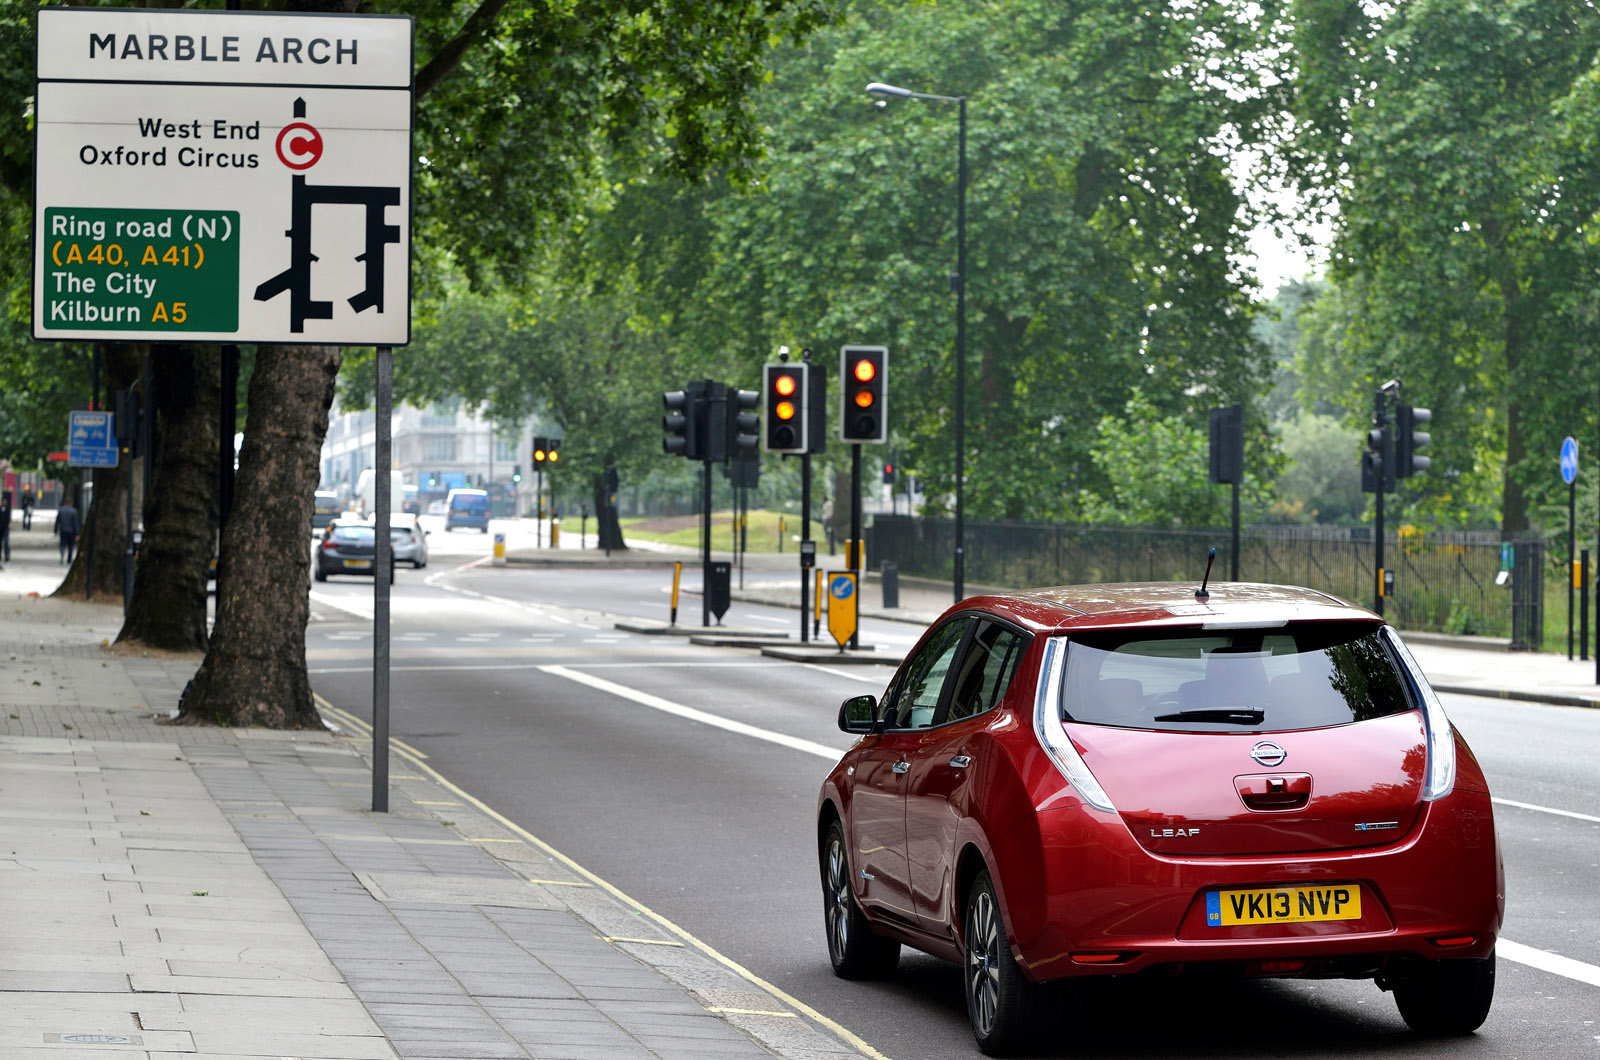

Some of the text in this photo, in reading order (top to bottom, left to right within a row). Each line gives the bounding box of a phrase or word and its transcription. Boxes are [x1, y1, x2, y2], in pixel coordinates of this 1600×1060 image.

[89, 33, 358, 65] MARBLE ARCH
[138, 118, 260, 140] West End
[79, 144, 259, 168] Oxford Circus
[52, 215, 232, 242] Ring road (N)
[52, 241, 205, 269] (A40, A41)
[52, 271, 157, 299] The City
[51, 301, 188, 323] Kilburn A5
[1150, 828, 1200, 838] LEAF
[1209, 912, 1219, 921] GB
[1230, 889, 1350, 919] VK13 NVP
